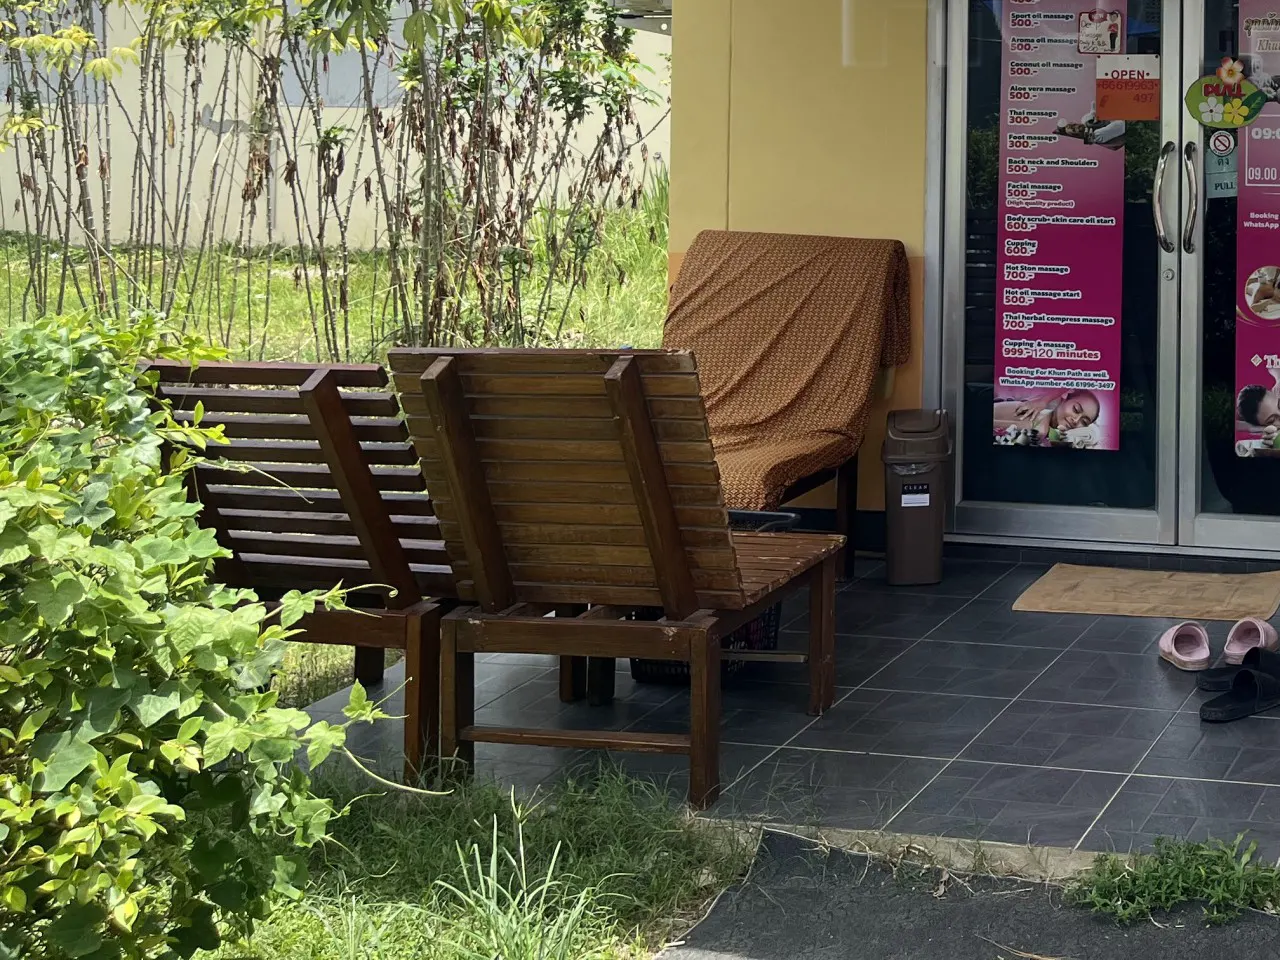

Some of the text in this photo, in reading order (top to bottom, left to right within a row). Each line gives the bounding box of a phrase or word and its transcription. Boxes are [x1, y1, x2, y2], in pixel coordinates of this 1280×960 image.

[1111, 70, 1145, 80] OPEN
[1248, 168, 1276, 180] 09.00
[1033, 349, 1053, 358] 120
[1057, 350, 1098, 358] minutes
